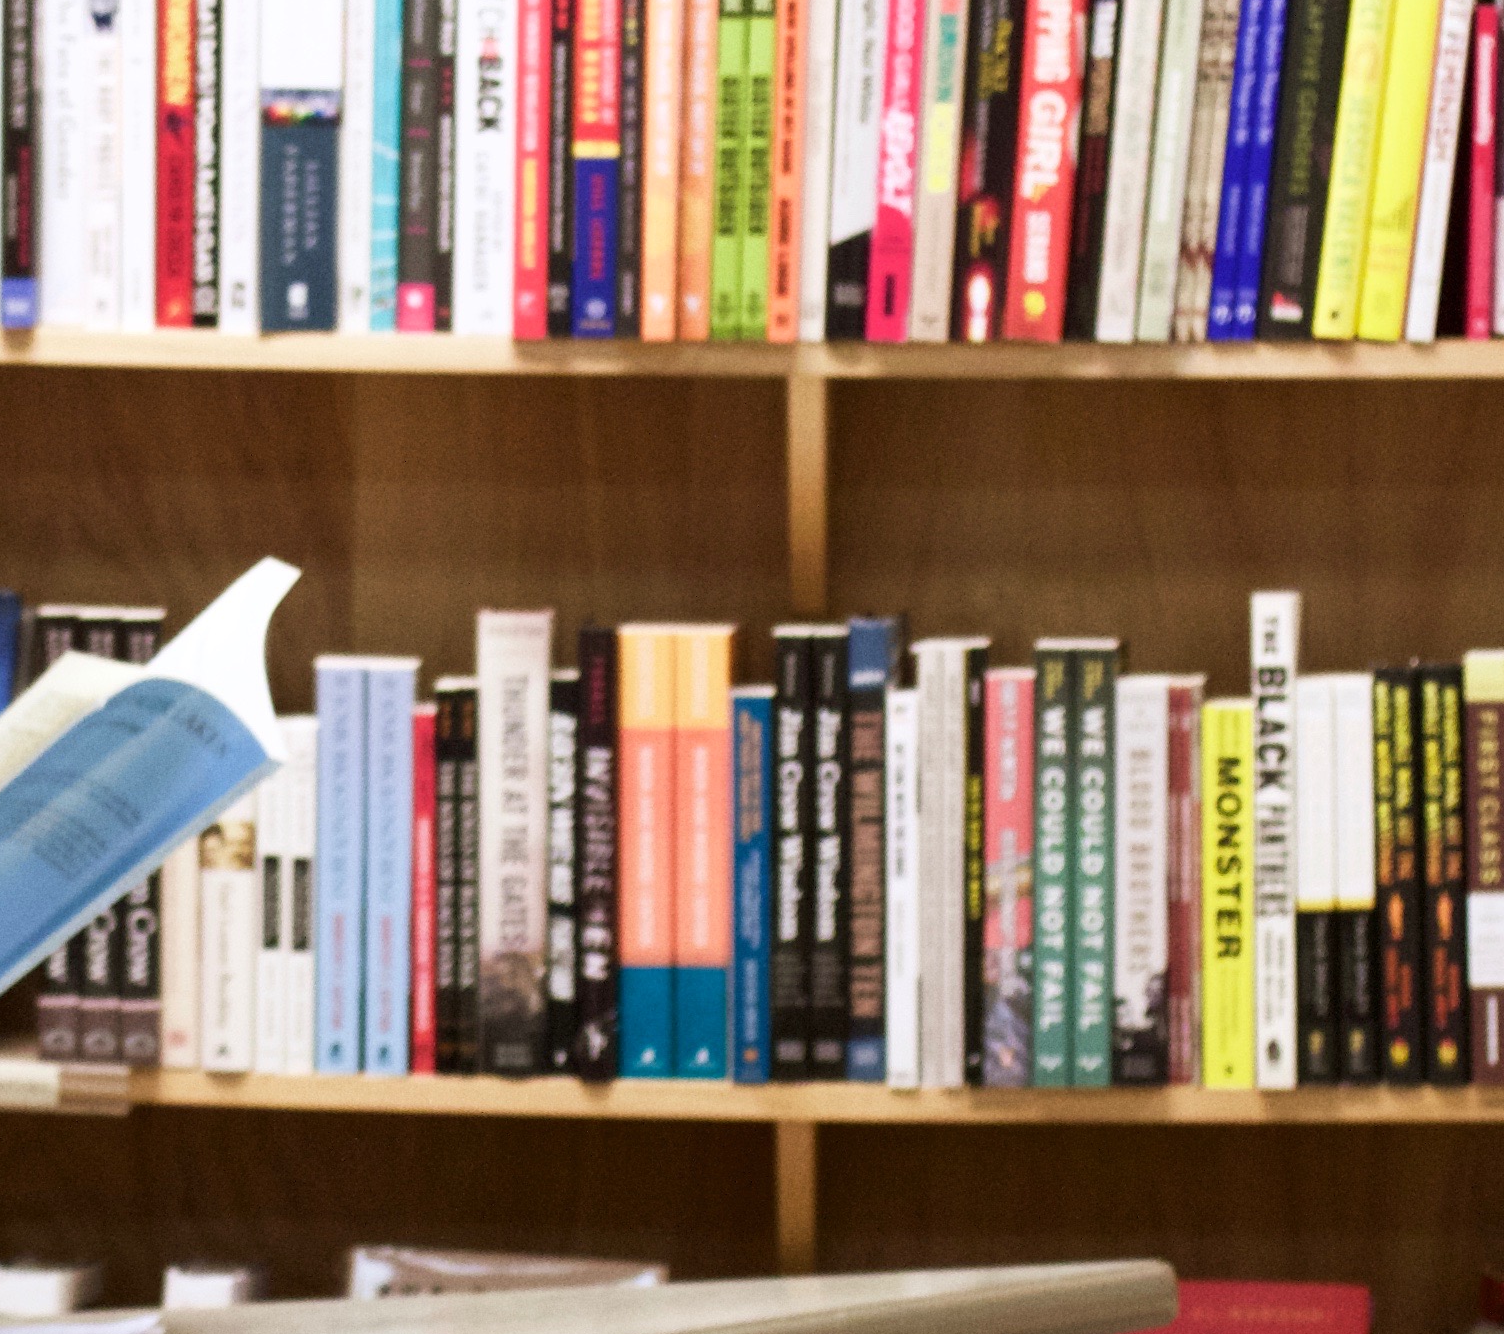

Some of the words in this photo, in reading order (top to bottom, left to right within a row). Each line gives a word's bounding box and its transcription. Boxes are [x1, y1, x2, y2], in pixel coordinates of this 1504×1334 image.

[476, 54, 508, 135] BACK
[1024, 90, 1069, 199] GIRL
[1263, 612, 1281, 656] THE
[500, 673, 530, 781] THUNDER
[778, 705, 803, 758] Jim
[816, 705, 841, 758] Jim
[1041, 703, 1066, 759] WE
[1081, 703, 1106, 759] WE
[1256, 664, 1289, 794] BLACK
[1477, 709, 1501, 793] FIRST
[500, 789, 530, 817] AT
[778, 760, 803, 830] Crow
[816, 760, 841, 830] Crow
[1041, 767, 1066, 876] COULD
[1081, 767, 1106, 876] COULD
[500, 825, 530, 868] THE
[851, 768, 883, 957] WILMINGTON
[1213, 754, 1245, 961] MONSTER
[1256, 801, 1291, 920] PANTHERS
[1477, 794, 1501, 885] CLASS
[500, 875, 530, 950] GATES
[778, 835, 803, 944] Wisdom
[816, 835, 841, 944] Wisdom
[1041, 887, 1066, 949] NOT
[1081, 887, 1106, 949] NOT
[851, 965, 883, 1018] TEN
[1041, 957, 1066, 1030] FAIL
[1081, 957, 1106, 1030] FAIL
